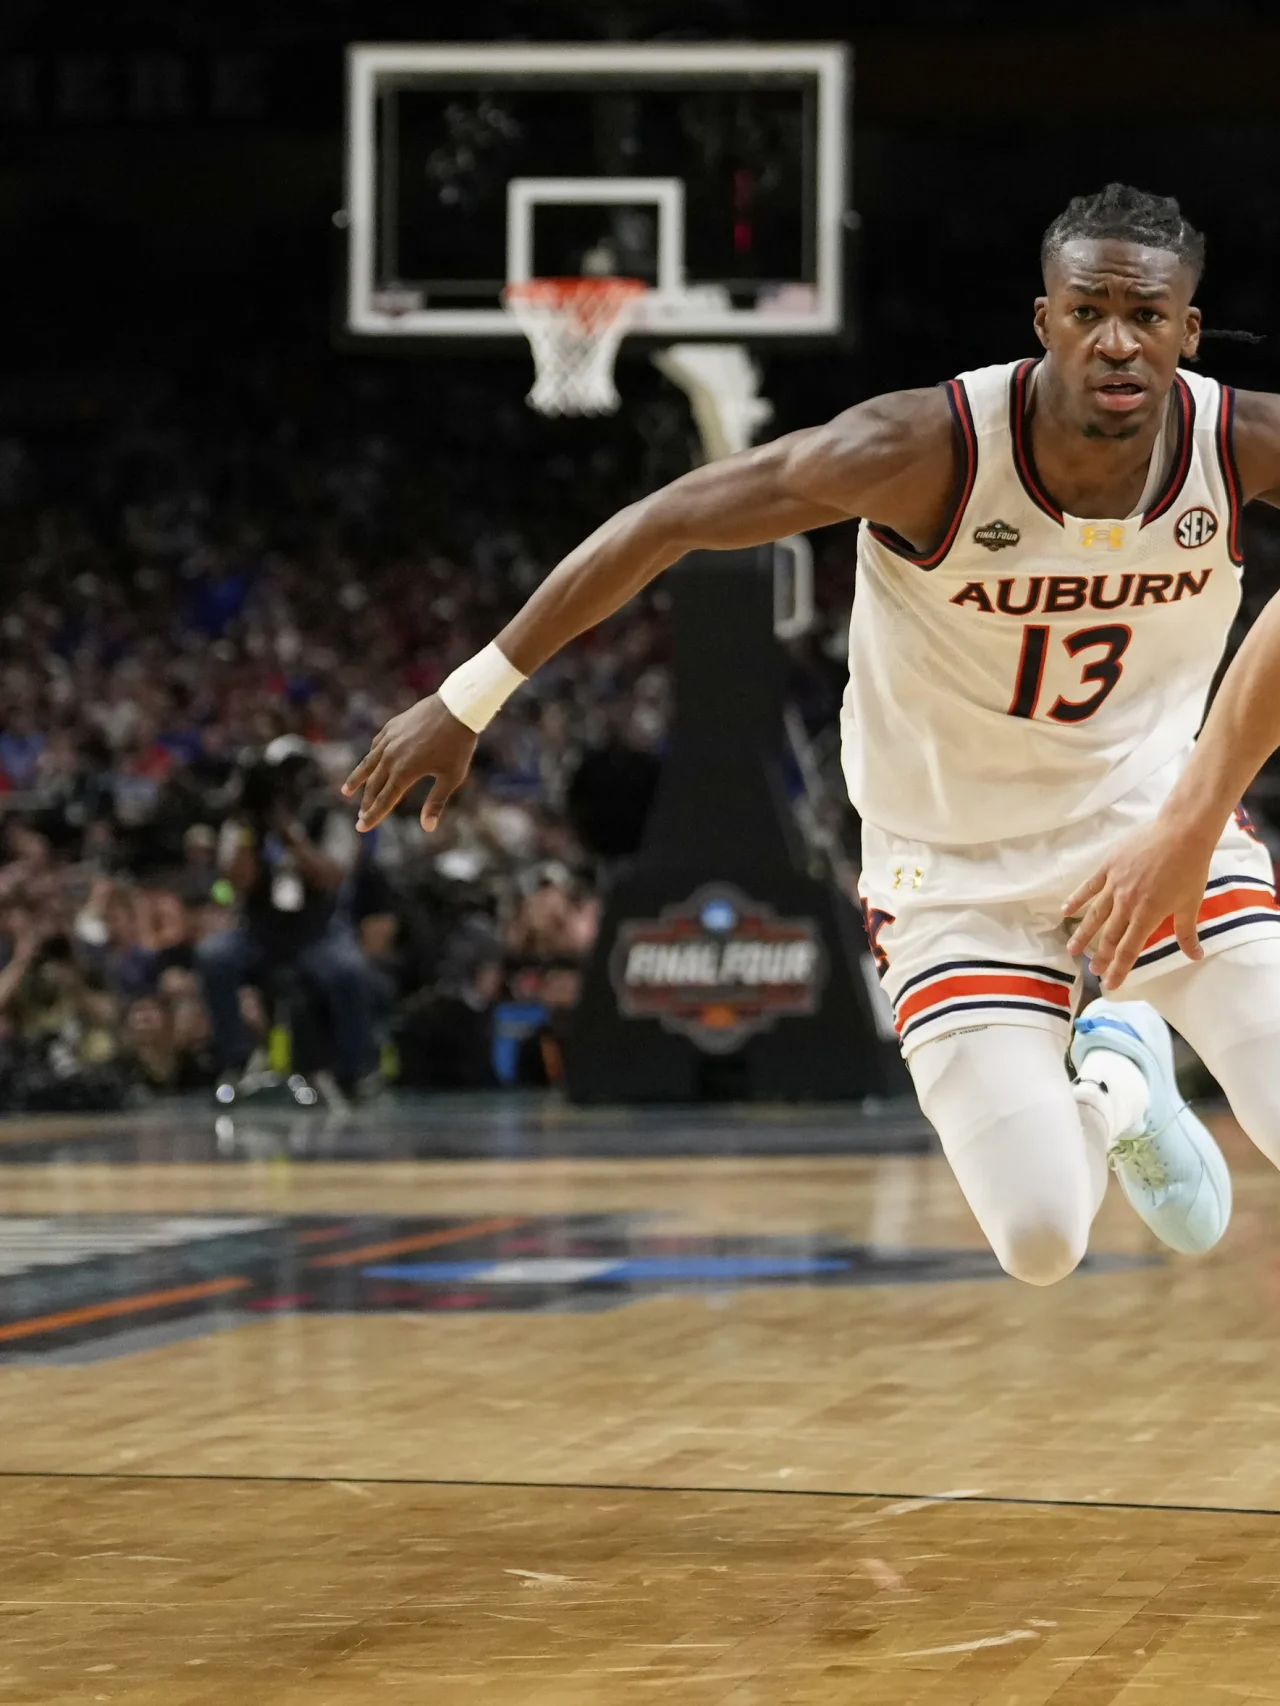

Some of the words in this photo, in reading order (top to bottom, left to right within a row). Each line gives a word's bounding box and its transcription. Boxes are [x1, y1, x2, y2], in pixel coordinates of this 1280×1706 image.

[975, 531, 996, 539] FINAL
[996, 531, 1018, 541] FOUR
[1178, 510, 1215, 547] SEC
[949, 568, 1213, 615] AUBURN
[1007, 623, 1132, 723] 13
[625, 941, 717, 986] FINAL
[717, 941, 817, 986] FOUR
